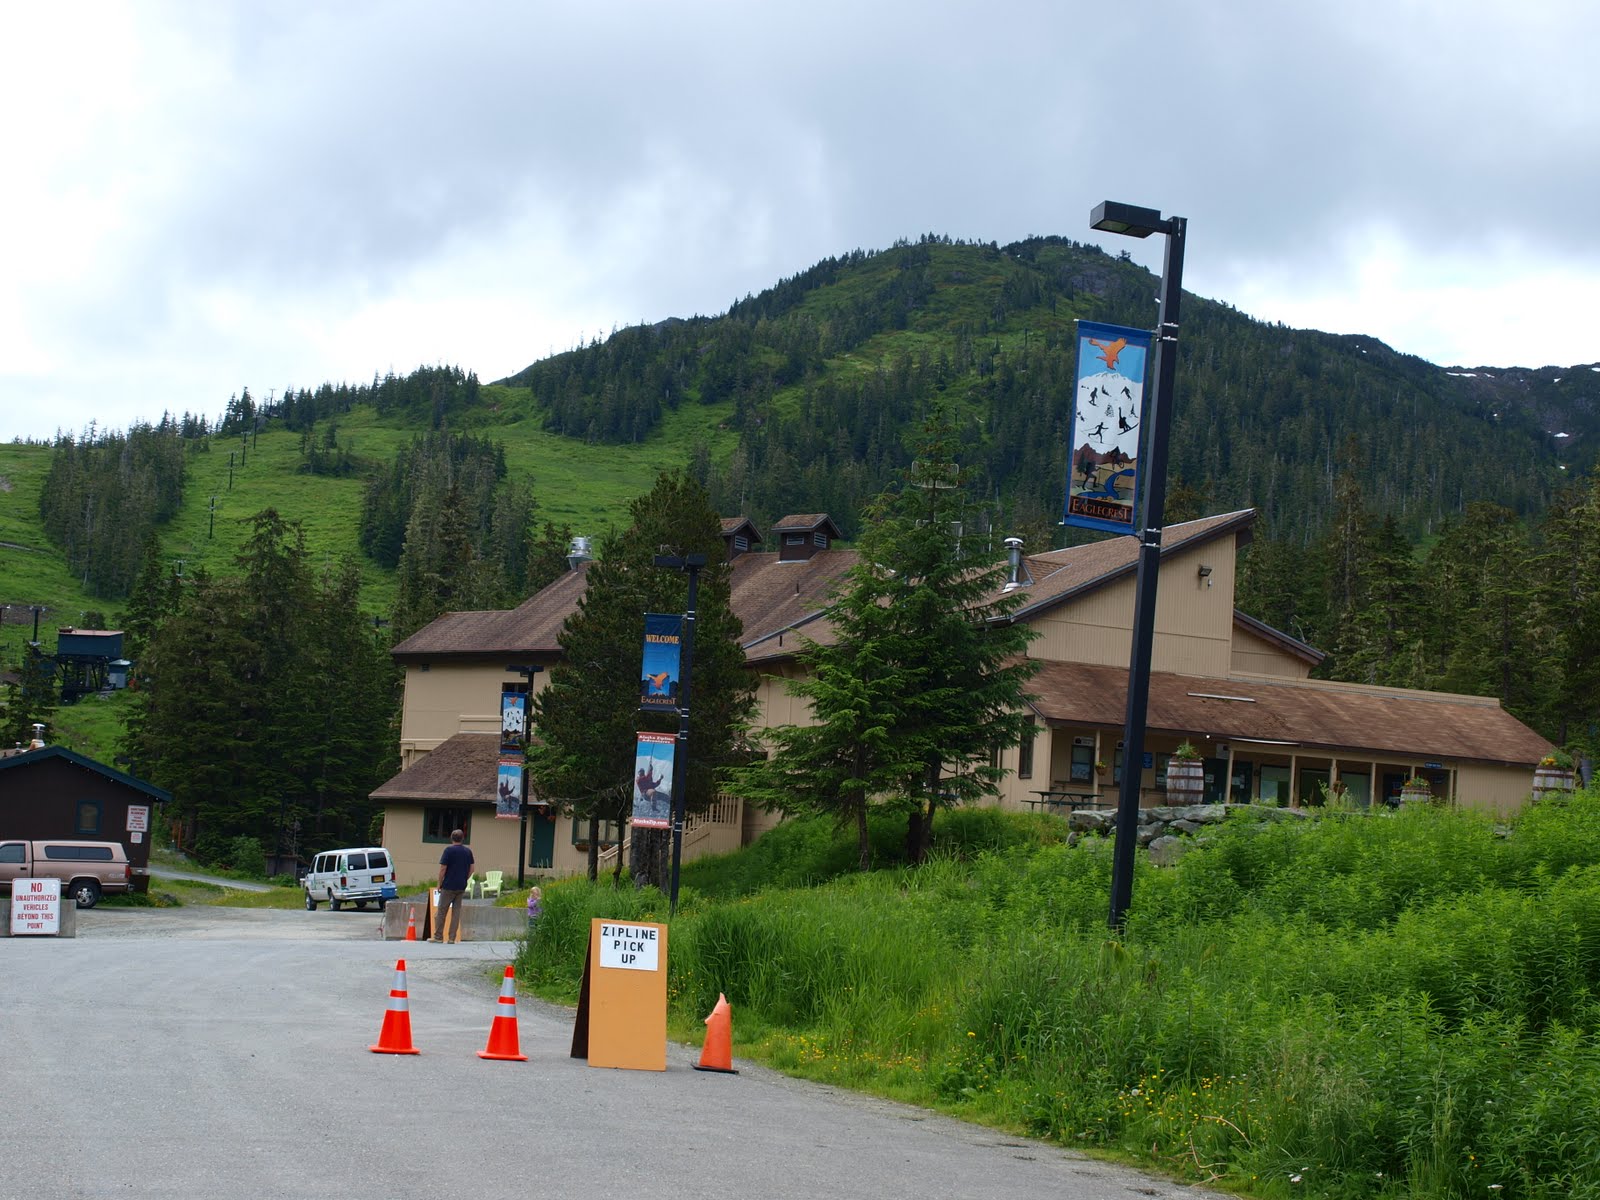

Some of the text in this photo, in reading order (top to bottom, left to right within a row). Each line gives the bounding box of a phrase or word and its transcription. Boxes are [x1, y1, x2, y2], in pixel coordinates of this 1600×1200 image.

[1072, 498, 1130, 519] EAGLECREST
[645, 634, 680, 645] WELCOME
[641, 696, 677, 705] EAGLECREST
[31, 883, 43, 893] NO
[602, 926, 656, 940] ZIPLINE
[614, 940, 644, 952] PICK
[621, 953, 636, 964] UP
